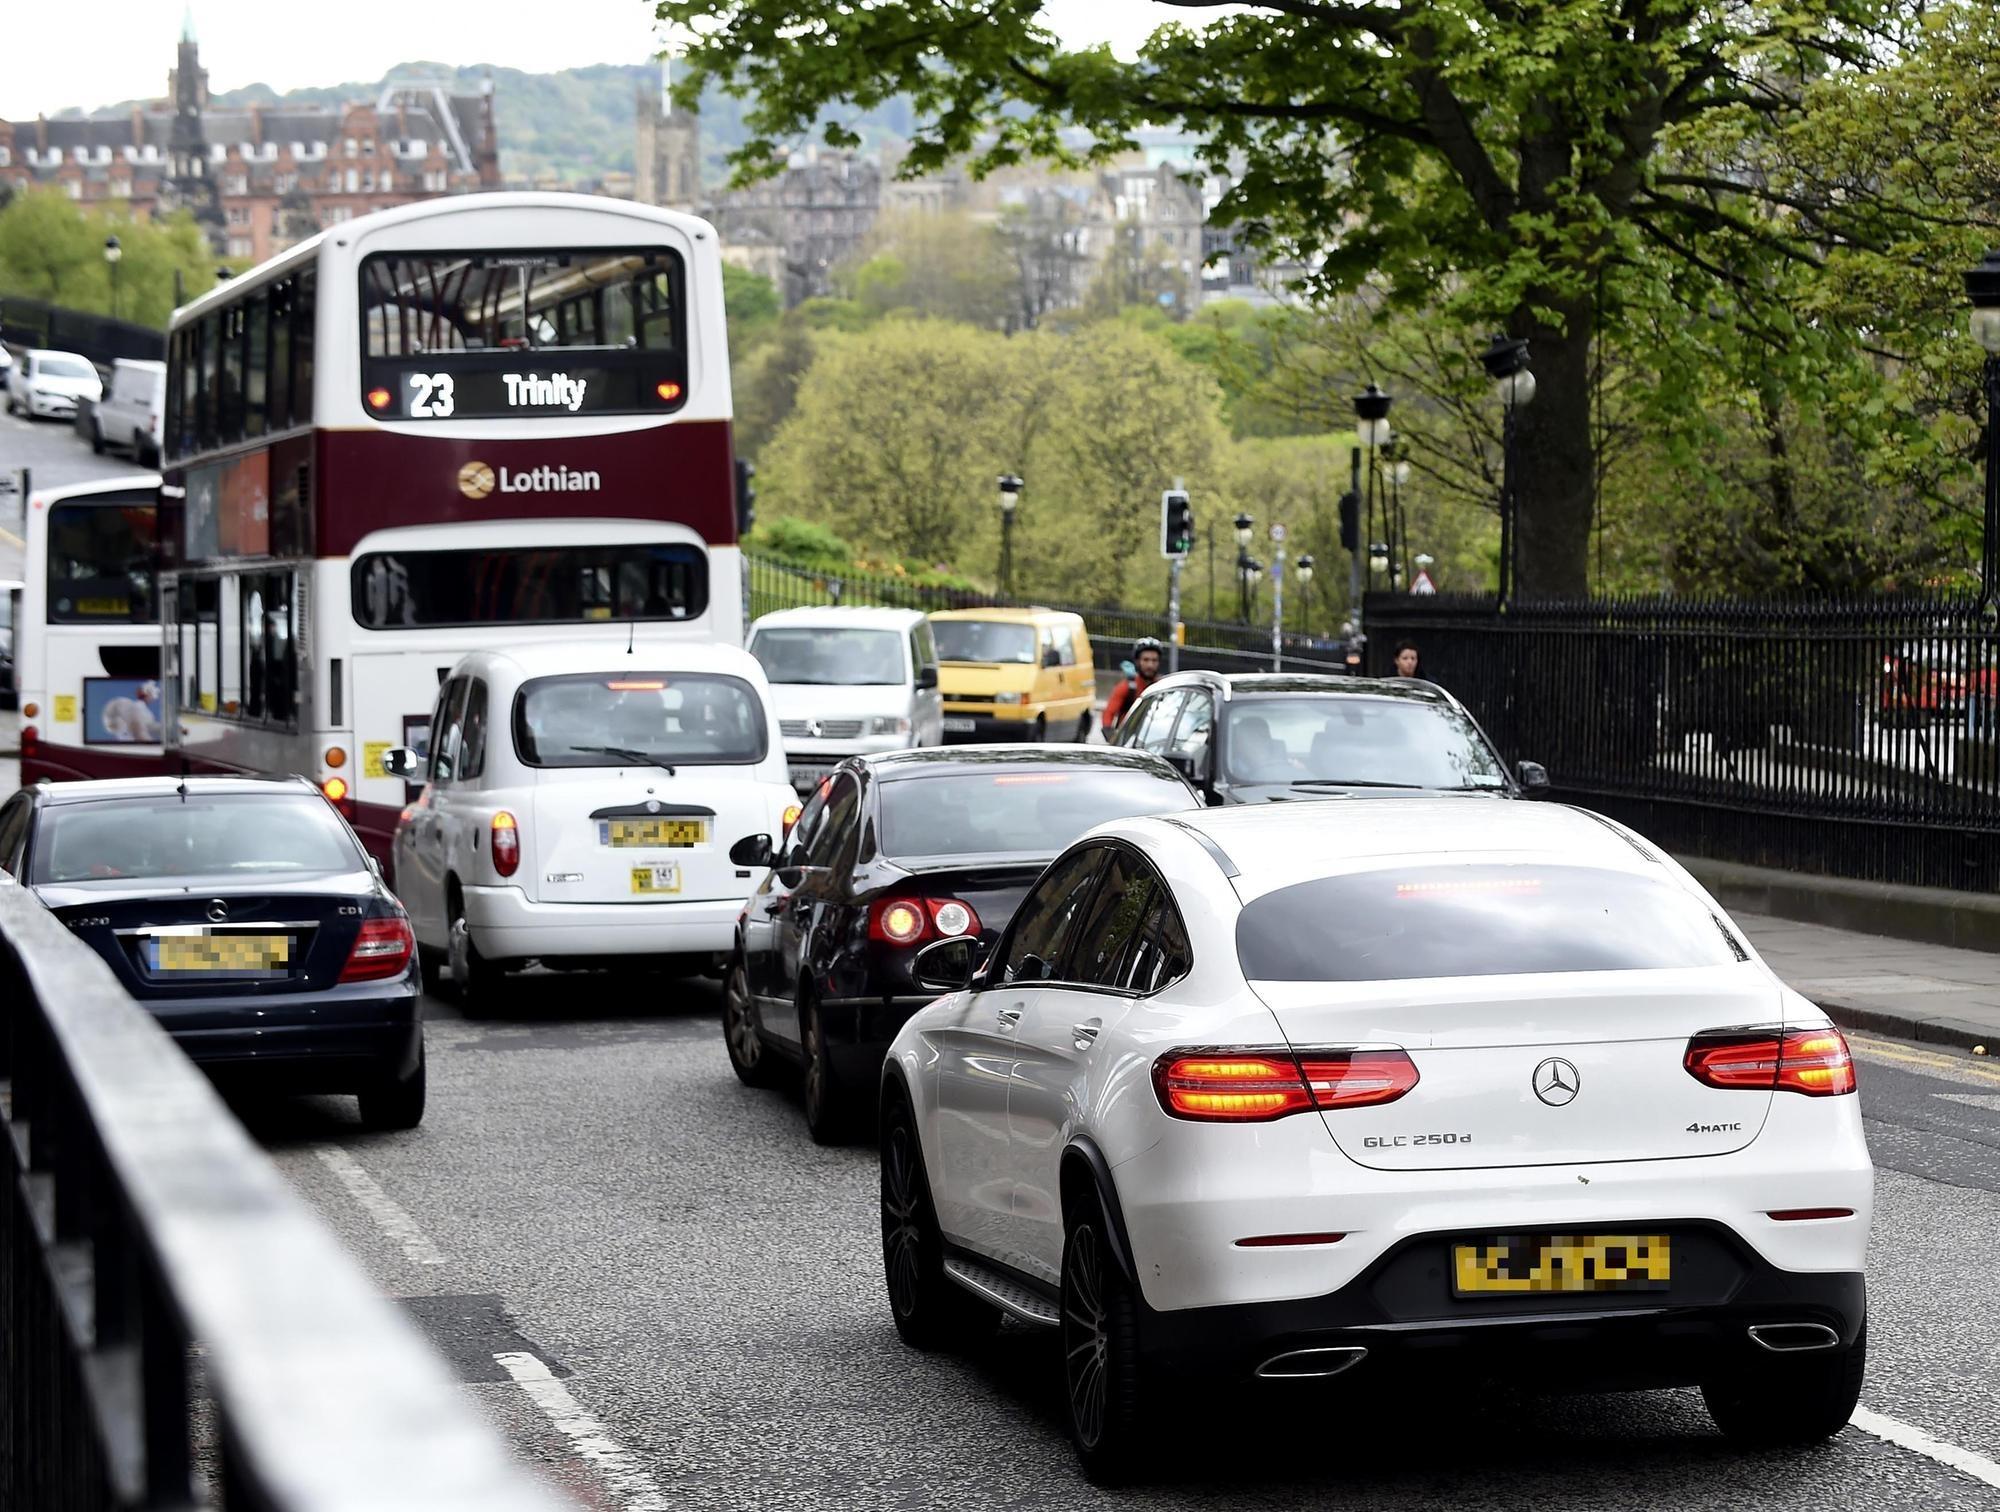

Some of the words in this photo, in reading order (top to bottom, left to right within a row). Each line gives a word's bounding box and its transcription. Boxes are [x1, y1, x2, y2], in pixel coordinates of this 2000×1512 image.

[410, 373, 454, 417] 23
[503, 373, 587, 411] Trinity
[500, 465, 600, 492] Lothian
[338, 906, 363, 915] CDI
[1686, 1122, 1742, 1133] 4MATIC
[1363, 1136, 1408, 1148] GLC
